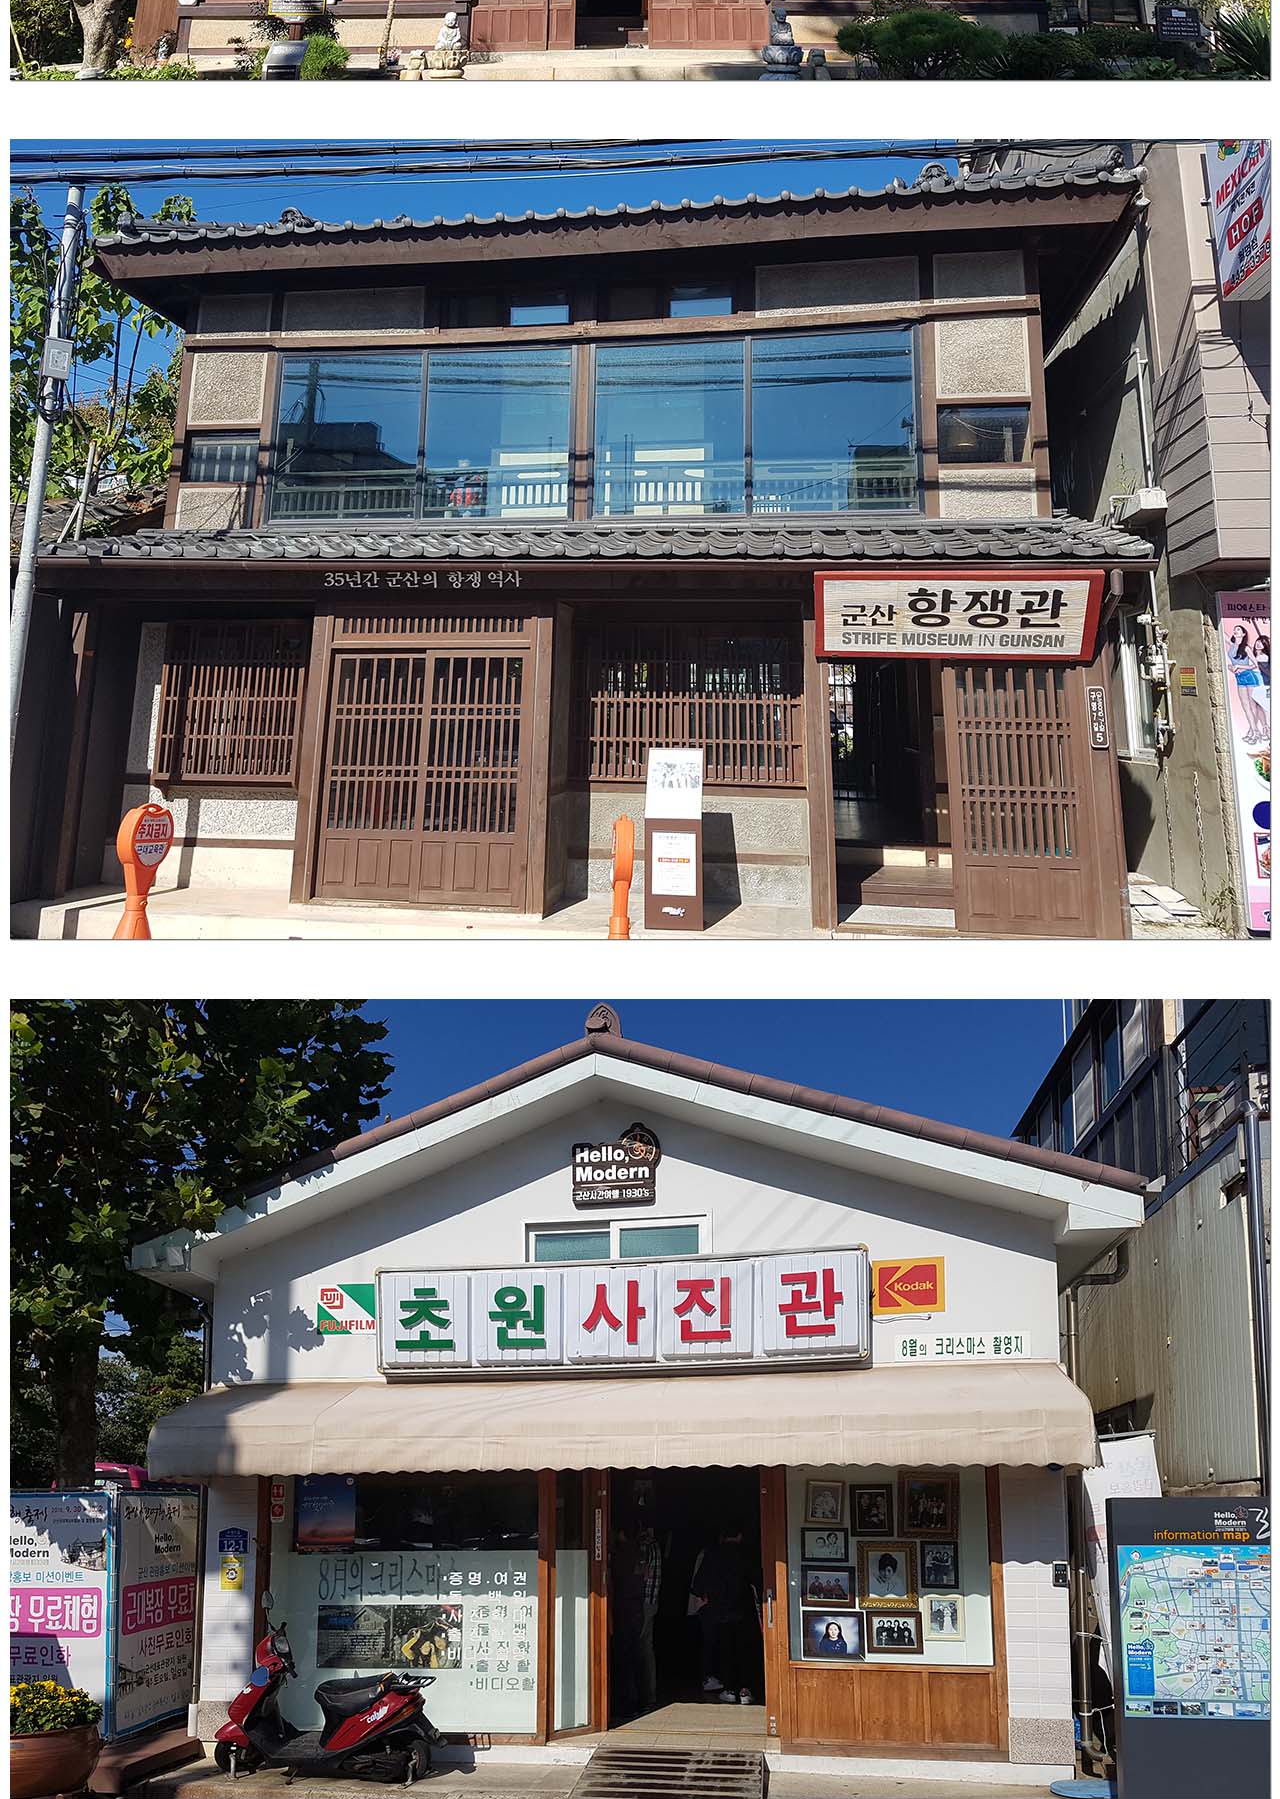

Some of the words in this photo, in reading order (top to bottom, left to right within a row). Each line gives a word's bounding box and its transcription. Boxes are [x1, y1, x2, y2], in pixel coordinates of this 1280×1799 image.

[1215, 139, 1265, 209] MEXICAN
[1231, 205, 1260, 245] HOF
[1230, 239, 1271, 287] 445-3579
[323, 571, 380, 588] 35년간
[384, 571, 438, 589] 군산의
[447, 571, 482, 589] 항쟁
[487, 570, 523, 588] 역사
[841, 603, 901, 627] 군산
[907, 587, 1069, 629] 항쟁관
[842, 631, 897, 646] STRIFE
[901, 632, 973, 647] MUSEUM
[978, 634, 996, 647] IN
[999, 634, 1065, 648] GUNSAN
[1096, 732, 1104, 743] 5
[138, 823, 169, 839] 주차금지
[575, 1146, 630, 1163] Hello,
[575, 1165, 650, 1182] Modern
[575, 1189, 620, 1201] 군산시간여행
[894, 1280, 934, 1292] Kodak
[320, 1319, 376, 1331] FUJIFILM
[901, 1338, 927, 1357] 8월의
[935, 1336, 986, 1356] 크리스마스
[992, 1335, 1024, 1355] 촬영지
[1214, 1511, 1238, 1520] Hello,
[154, 1533, 174, 1543] Hello,
[1153, 1529, 1220, 1541] information
[1222, 1531, 1251, 1543] map
[154, 1544, 181, 1554] Modern
[223, 1540, 244, 1552] 12-1
[35, 1571, 85, 1583] 미션이벤트
[28, 1593, 98, 1634] 무료체험
[126, 1586, 164, 1630] 근대복장
